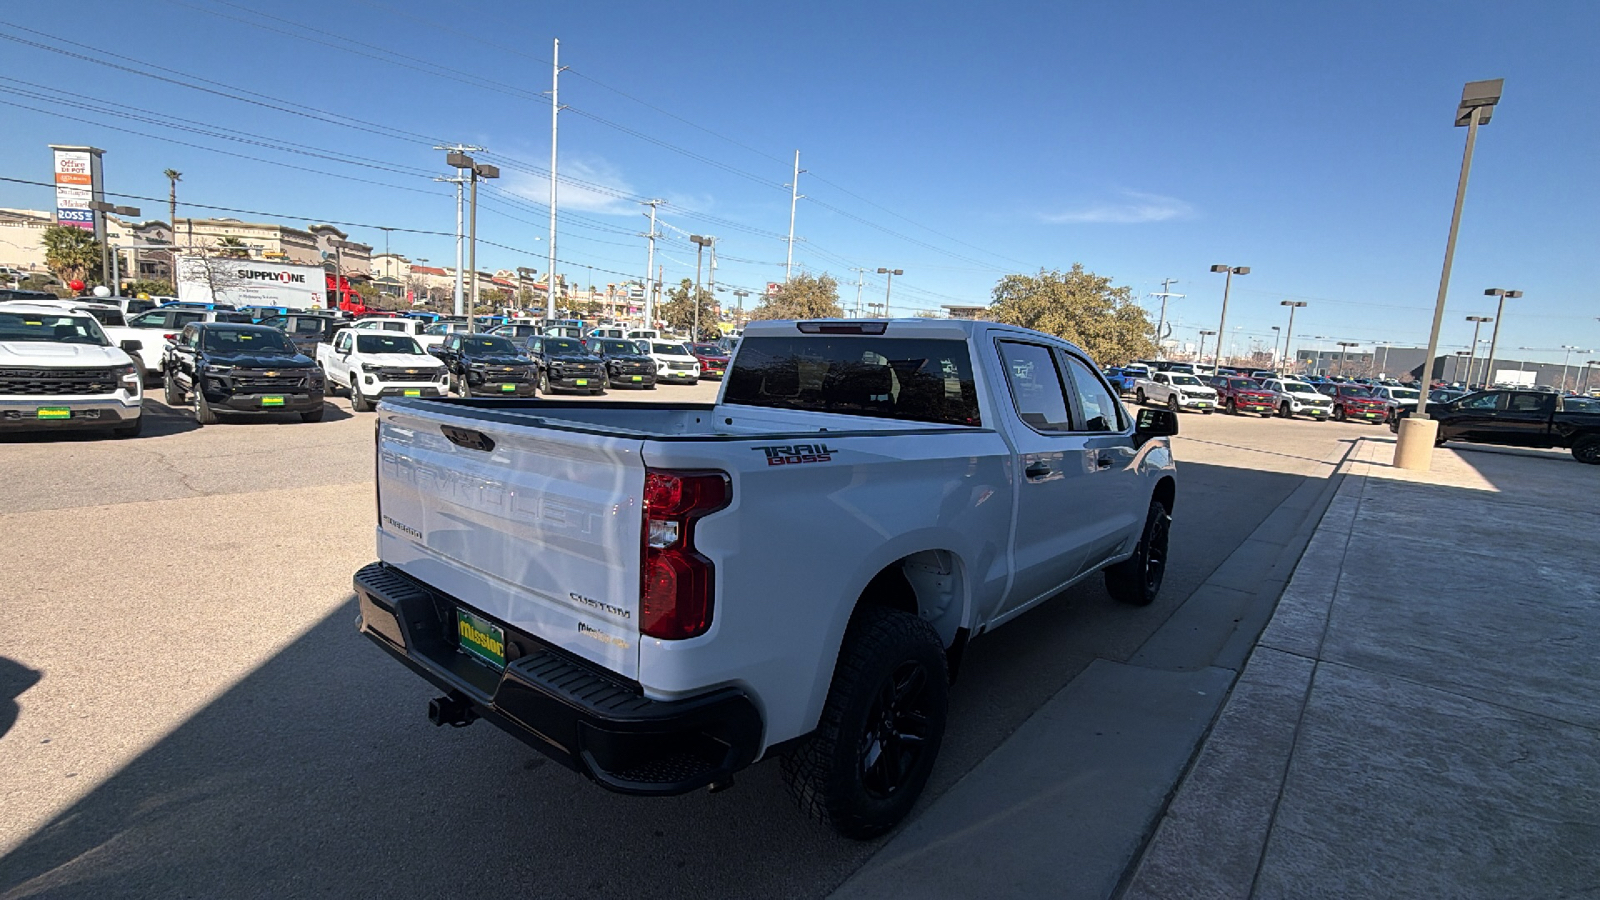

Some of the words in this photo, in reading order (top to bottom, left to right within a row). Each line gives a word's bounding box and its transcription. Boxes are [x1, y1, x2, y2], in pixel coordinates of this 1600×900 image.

[58, 210, 84, 220] ROSS
[238, 269, 306, 284] SUPPLYONE
[750, 443, 838, 457] TRAIL
[768, 453, 832, 466] BOSS
[569, 592, 631, 619] CUSTOM
